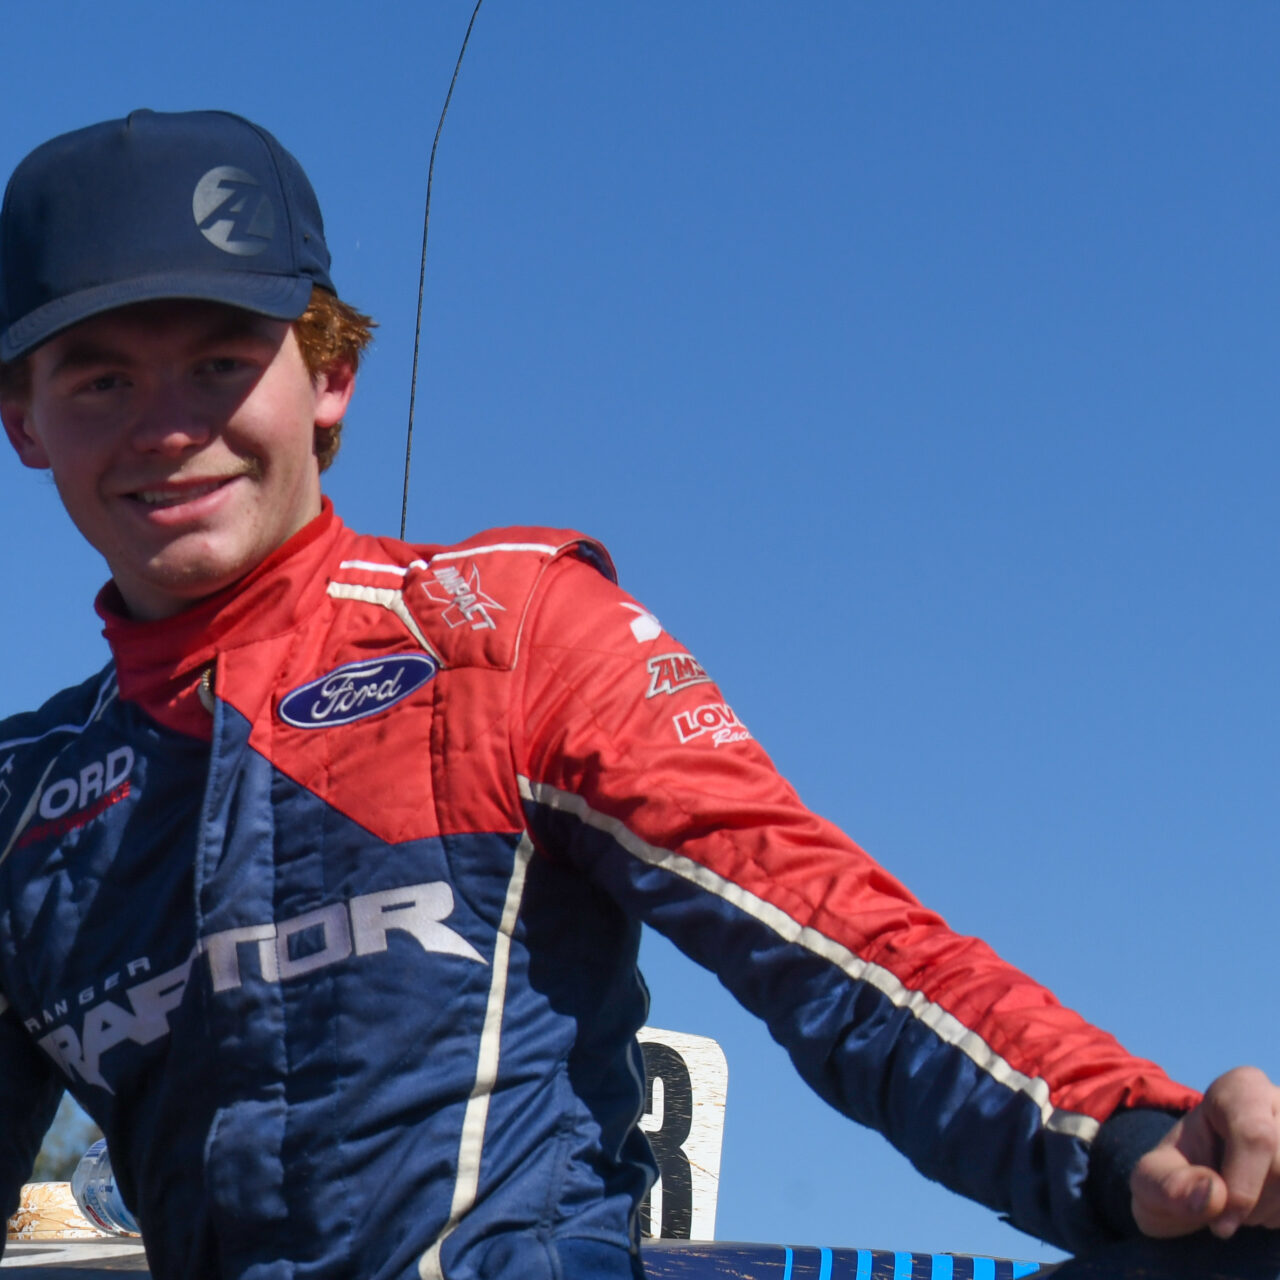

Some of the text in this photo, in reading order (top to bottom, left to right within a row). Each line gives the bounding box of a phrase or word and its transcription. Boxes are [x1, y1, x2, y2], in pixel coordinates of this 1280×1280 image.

[310, 665, 406, 720] Ford
[39, 745, 135, 820] ORD
[24, 956, 151, 1034] RANGER
